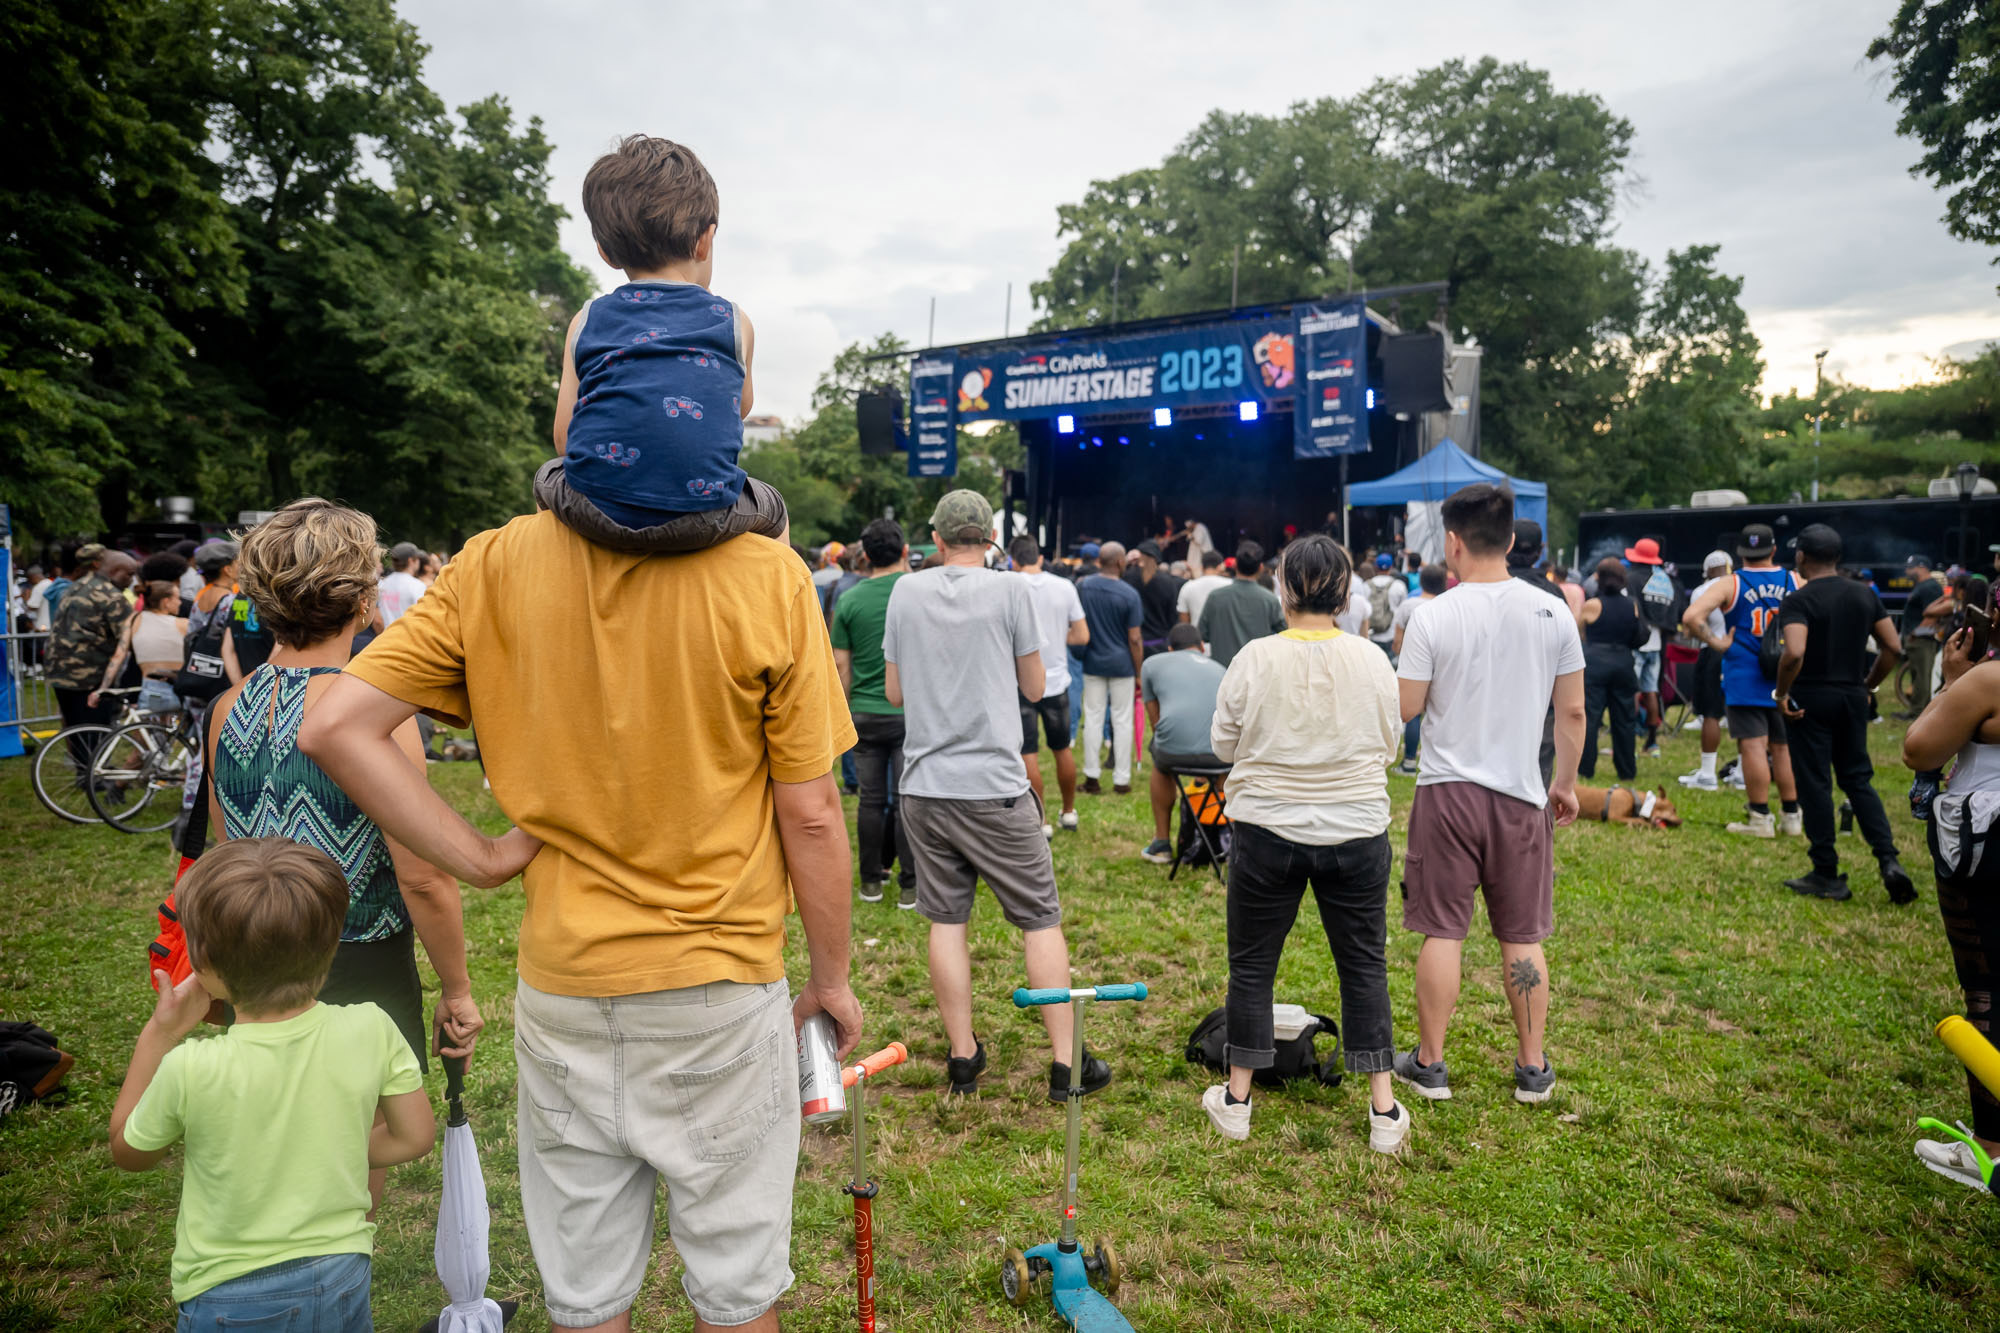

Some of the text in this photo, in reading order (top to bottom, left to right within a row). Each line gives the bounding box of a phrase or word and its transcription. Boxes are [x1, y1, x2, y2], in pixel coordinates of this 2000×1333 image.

[1049, 352, 1107, 373] CityParks
[1005, 344, 1243, 409] SUMMERSTAGE 2023
[1744, 584, 1790, 604] FAZIE
